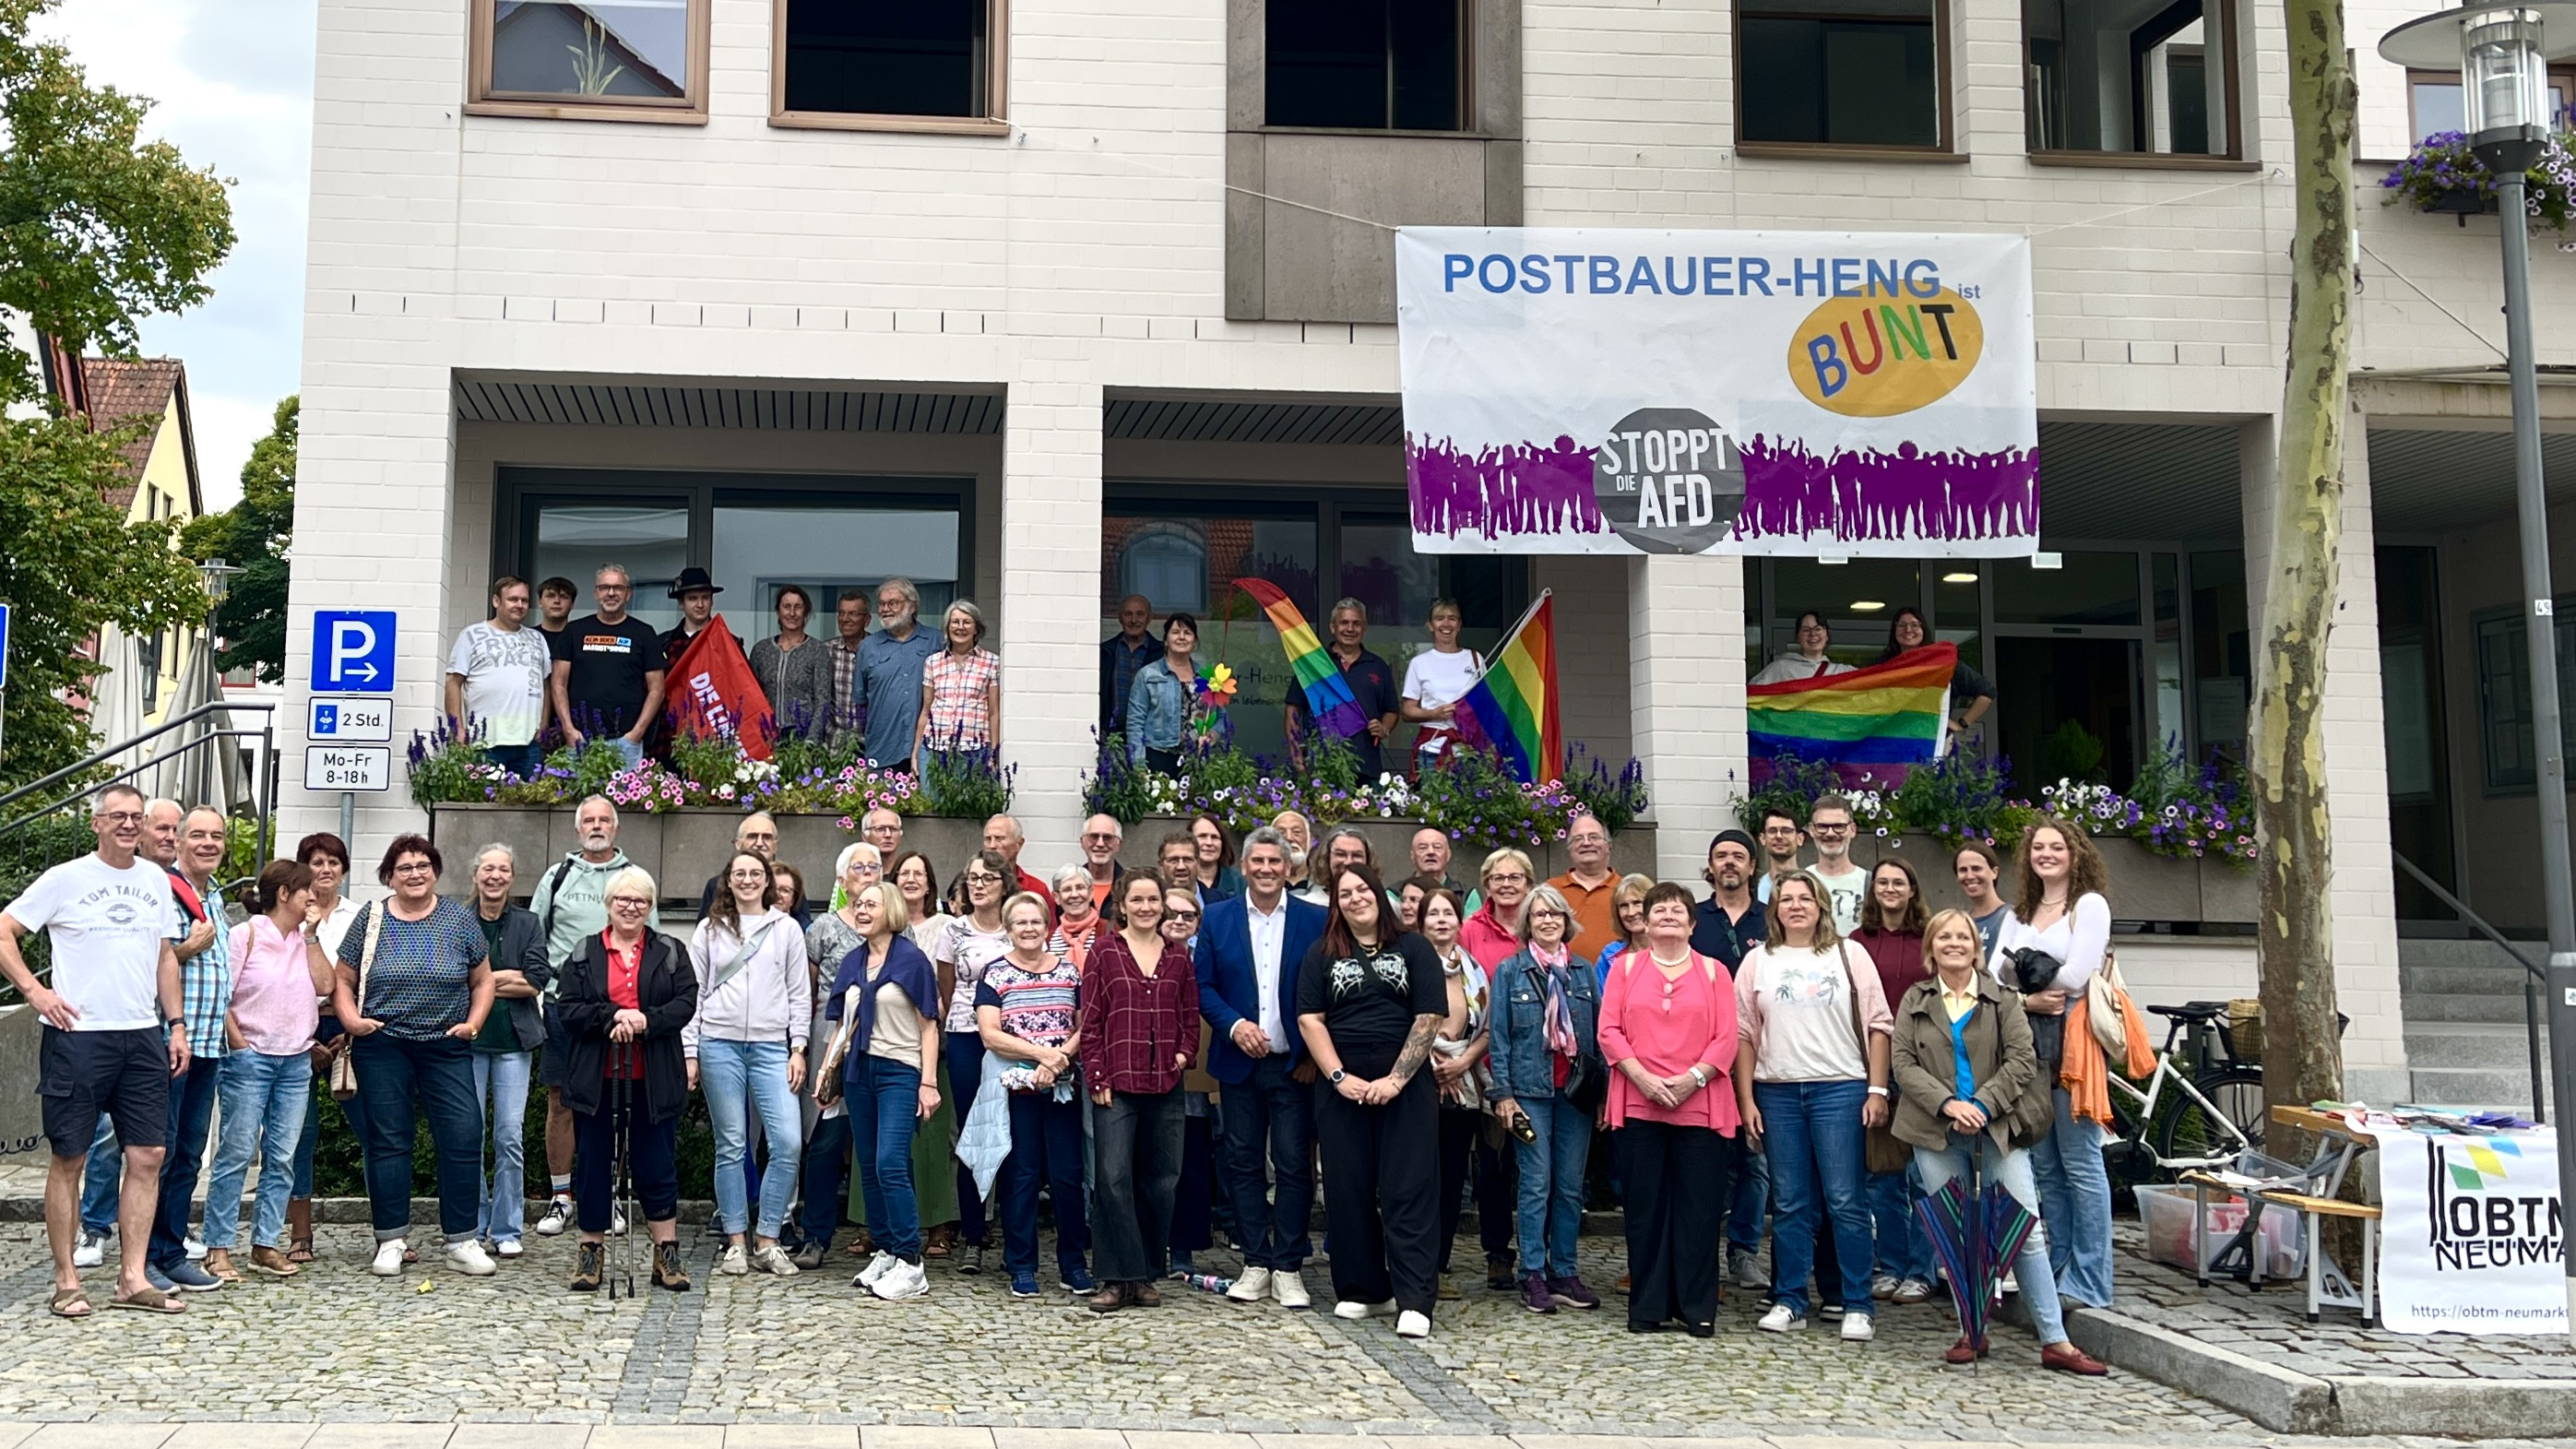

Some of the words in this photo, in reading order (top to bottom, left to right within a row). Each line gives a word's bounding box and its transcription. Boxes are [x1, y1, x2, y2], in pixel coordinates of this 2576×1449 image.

[1443, 254, 1941, 299] POSTBAUER-HENG
[1957, 282, 1981, 301] ist
[1807, 303, 1960, 398] BUNT
[1601, 428, 1730, 476] STOPPT
[1615, 473, 1637, 493] DIE
[1637, 473, 1714, 529] AFD
[329, 620, 376, 683] P
[342, 713, 351, 727] 2
[355, 713, 384, 728] Std.
[323, 753, 372, 767] Mo-Fr
[78, 886, 110, 907] TOM
[114, 885, 159, 908] TAILOR
[2435, 1234, 2567, 1272] NEUMA
